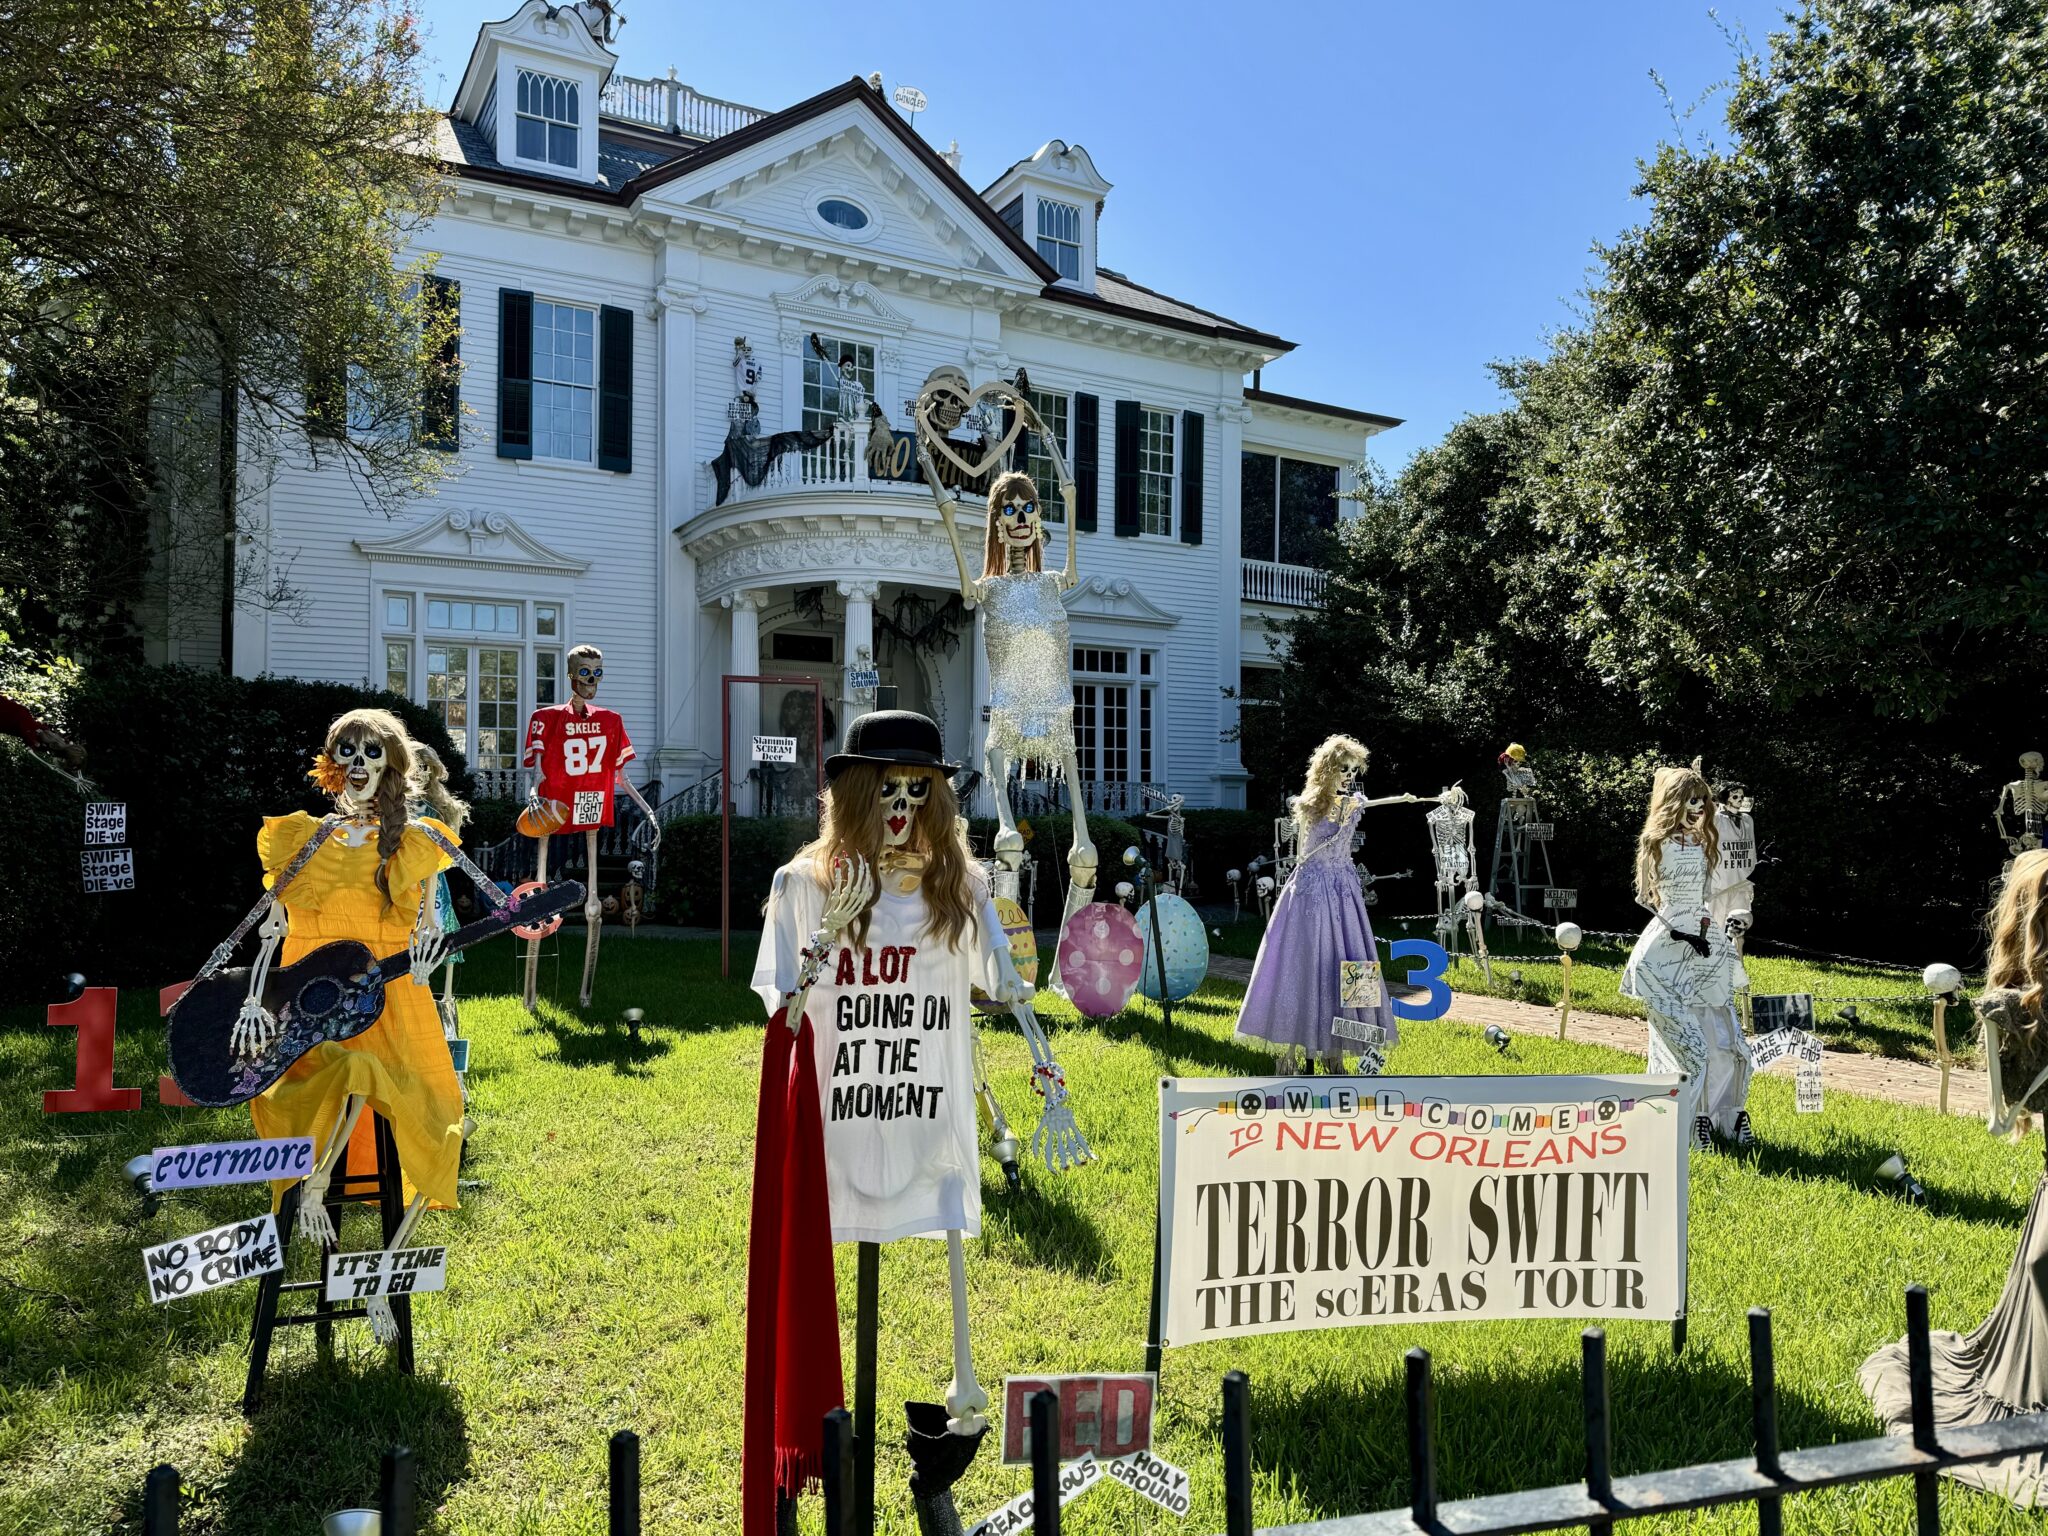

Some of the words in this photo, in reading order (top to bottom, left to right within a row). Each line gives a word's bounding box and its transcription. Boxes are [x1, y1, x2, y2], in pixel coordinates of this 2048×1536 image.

[745, 369, 756, 385] 9
[850, 671, 878, 680] SPINAL
[851, 680, 879, 688] COLUMN
[531, 720, 545, 735] 87
[565, 722, 601, 736] SKELCE
[563, 735, 607, 776] 87
[756, 745, 792, 754] SCREAM
[574, 802, 603, 813] TIGHT
[578, 791, 600, 803] HER
[87, 803, 125, 816] SWIFT
[578, 812, 599, 824] END
[86, 816, 124, 830] Stage
[86, 830, 125, 844] DIE-ve
[1722, 841, 1753, 851] SATURDAY
[81, 849, 130, 864] SWIFT
[1724, 859, 1752, 869] FEMUR
[1729, 850, 1749, 860] NIGHT
[82, 863, 131, 877] Stage
[84, 877, 134, 892] DIE-ve
[1544, 890, 1577, 899] SKELETON
[1551, 898, 1569, 907] CREW
[835, 947, 856, 986] A
[862, 945, 917, 986] LOT
[1390, 939, 1452, 1021] 3
[836, 992, 915, 1032] GOING
[922, 994, 950, 1031] ON
[1333, 1018, 1385, 1045] HAUNTED
[1791, 1029, 1809, 1047] HOW
[1750, 1034, 1777, 1057] HATE
[1779, 1028, 1787, 1041] IT
[832, 1038, 867, 1078] AT
[875, 1037, 921, 1075] THE
[1365, 1047, 1386, 1068] LONG
[1757, 1044, 1783, 1067] HERE
[1787, 1042, 1798, 1056] IT
[1800, 1047, 1821, 1065] END?
[831, 1081, 944, 1122] MOMENT
[1797, 1088, 1821, 1100] broken
[1286, 1091, 1571, 1132] WELCOME
[1800, 1099, 1820, 1111] heart
[1228, 1122, 1264, 1148] TO
[1276, 1121, 1400, 1153] NEW
[1410, 1124, 1628, 1168] ORLEANS
[155, 1140, 312, 1183] evermore
[1196, 1176, 1433, 1282] TERROR
[1467, 1172, 1649, 1266] SWIFT
[147, 1244, 190, 1275] NO
[333, 1252, 383, 1277] IT'S
[389, 1247, 444, 1272] TIME
[152, 1268, 194, 1300] NO
[201, 1243, 278, 1286] CRIME
[352, 1274, 382, 1298] TO
[386, 1271, 417, 1294] GO
[1196, 1279, 1296, 1331] THE
[1514, 1268, 1648, 1310] TOUR
[1006, 1378, 1152, 1458] RED
[1133, 1451, 1187, 1490] HOLY
[1109, 1460, 1188, 1512] GROUND
